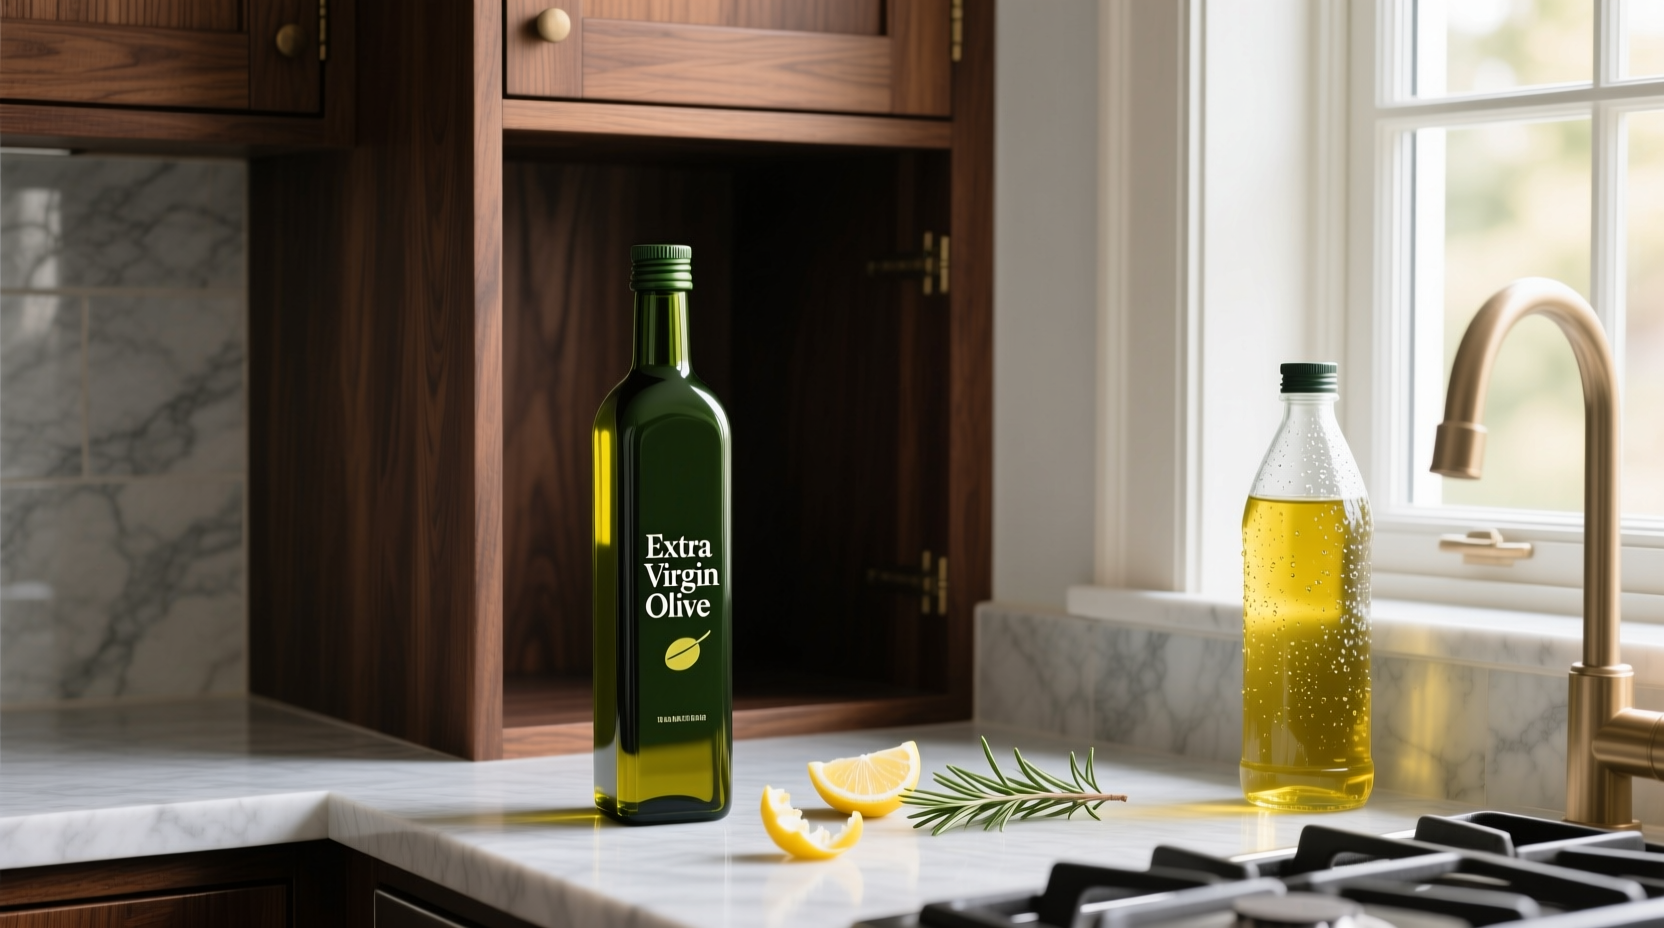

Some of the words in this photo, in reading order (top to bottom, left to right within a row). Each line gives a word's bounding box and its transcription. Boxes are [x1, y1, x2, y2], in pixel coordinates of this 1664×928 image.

[645, 533, 713, 558] Extra
[643, 561, 720, 594] Virgin
[645, 592, 711, 618] Olive
